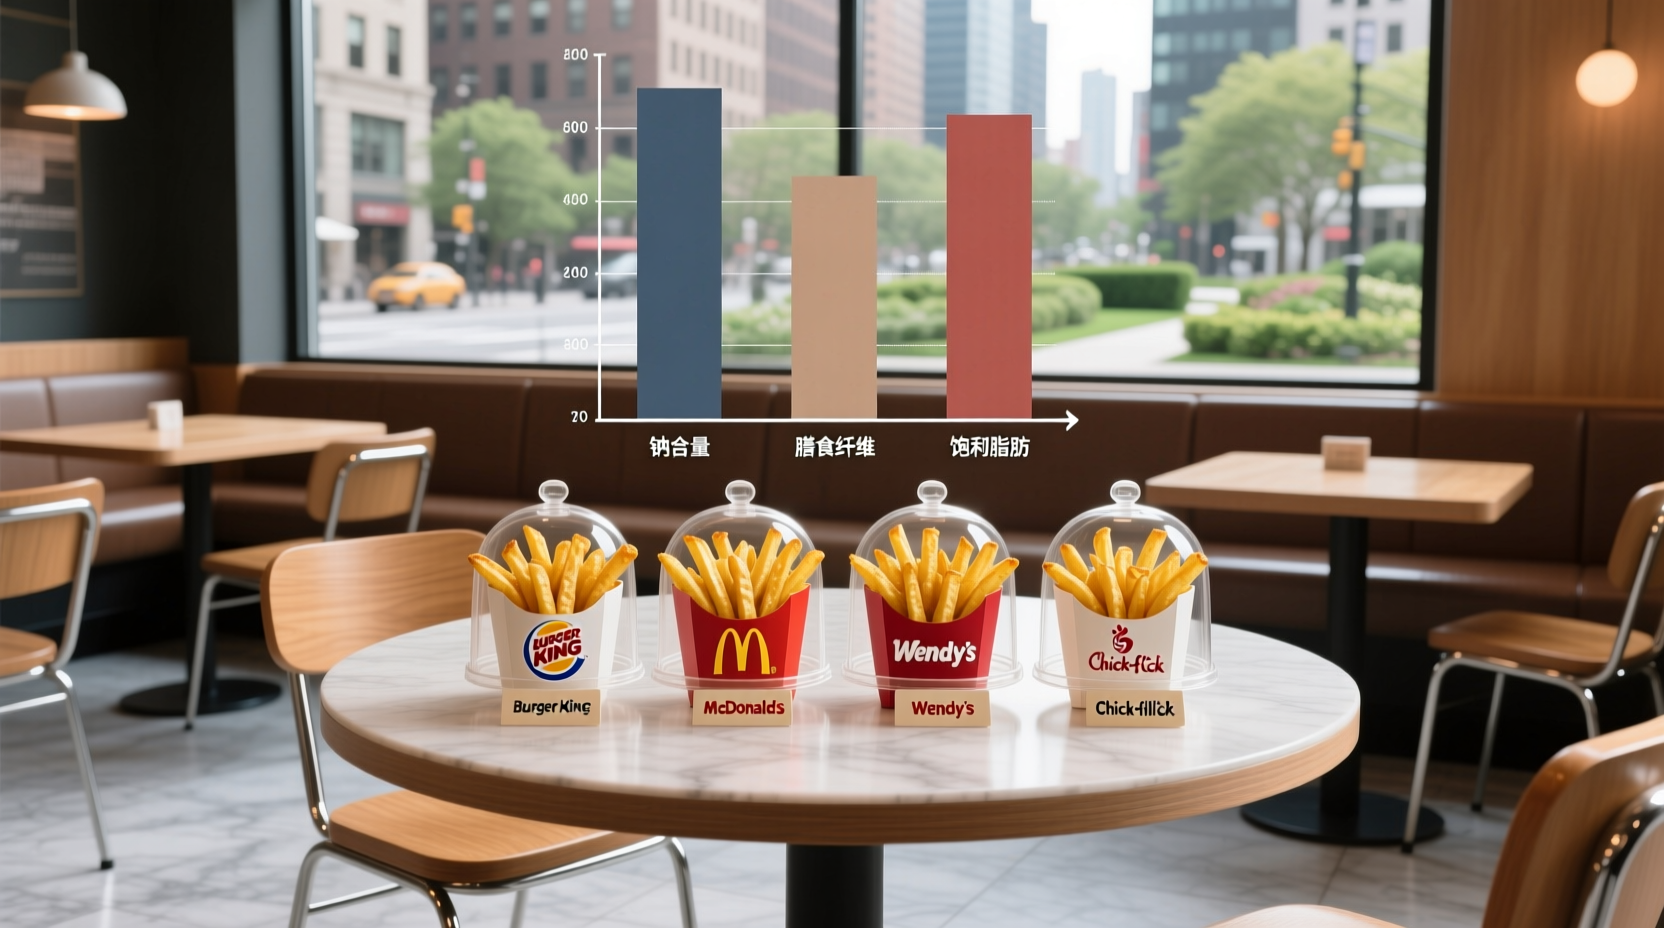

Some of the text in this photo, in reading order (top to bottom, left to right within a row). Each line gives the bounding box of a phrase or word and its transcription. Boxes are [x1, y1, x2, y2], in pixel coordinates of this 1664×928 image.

[533, 639, 582, 667] KING
[893, 639, 977, 668] Wendy's
[513, 700, 558, 716] Burger
[703, 700, 785, 715] McDonalds
[911, 700, 975, 719] Wendy's
